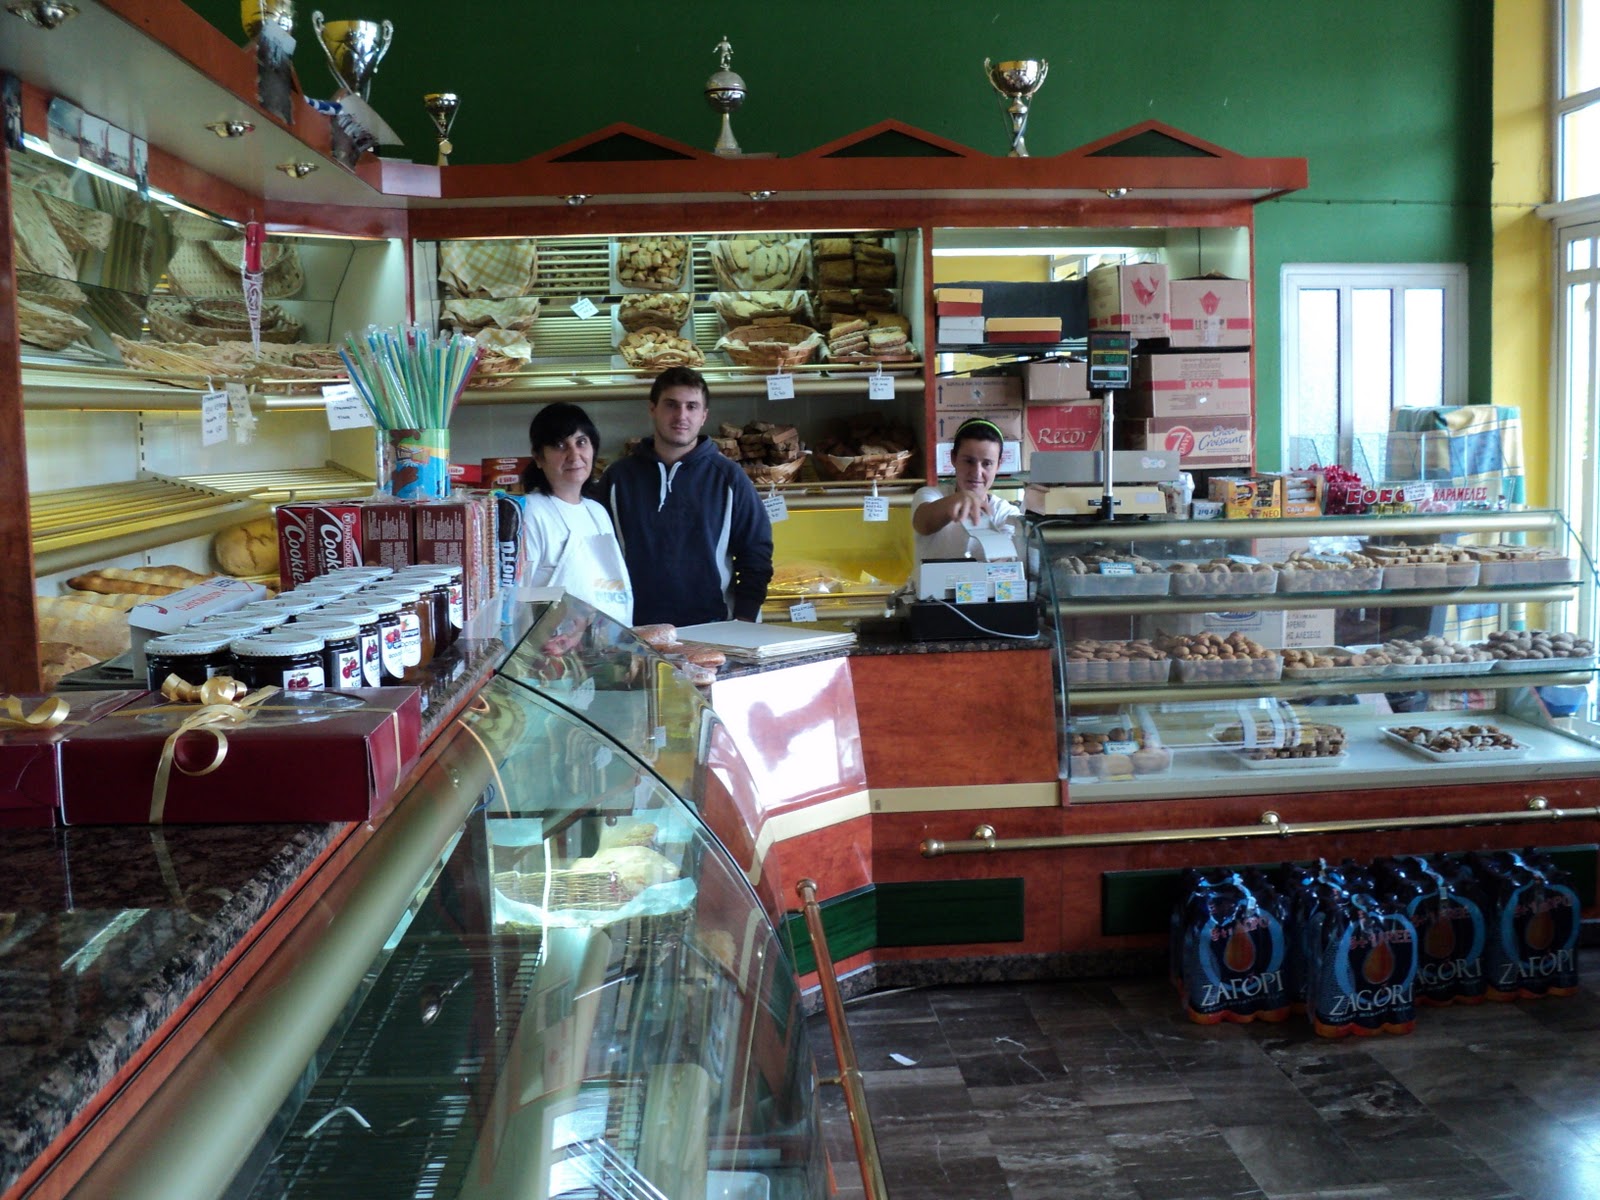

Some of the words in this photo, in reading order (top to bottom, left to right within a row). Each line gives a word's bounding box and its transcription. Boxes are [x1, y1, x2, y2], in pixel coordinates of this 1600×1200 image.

[1037, 427, 1092, 444] Recor
[1198, 434, 1247, 451] Croissant
[1212, 424, 1239, 438] Choco
[284, 524, 307, 586] Cookie
[320, 524, 342, 571] Cook
[1417, 957, 1483, 985] AGORI
[1329, 982, 1414, 1016] ZAGORI
